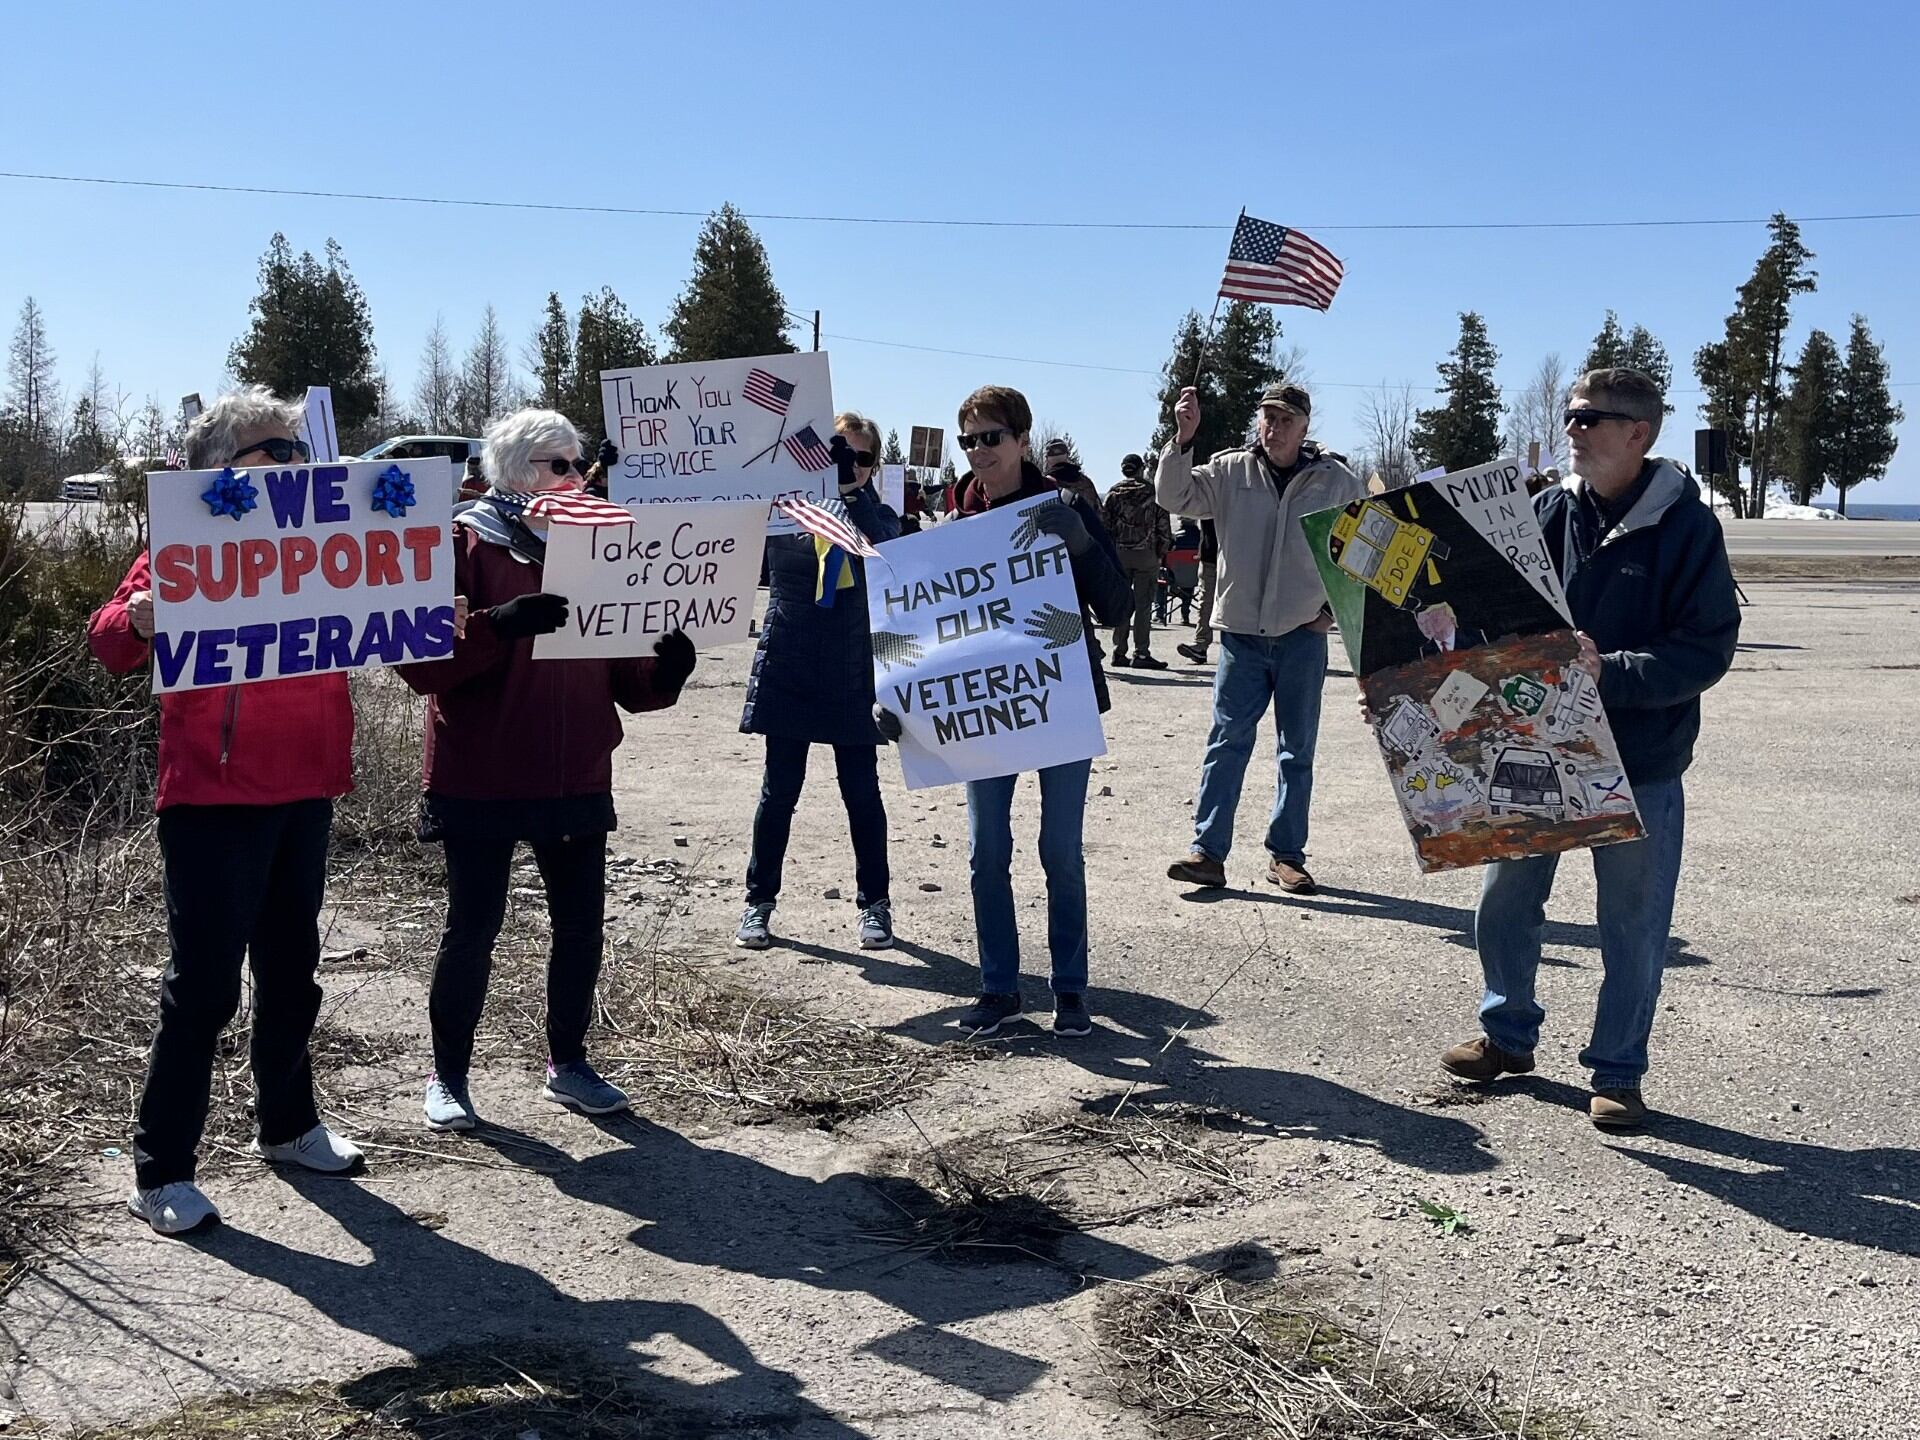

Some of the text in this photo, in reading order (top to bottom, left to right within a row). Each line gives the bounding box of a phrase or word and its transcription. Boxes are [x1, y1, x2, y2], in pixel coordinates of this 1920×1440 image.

[620, 415, 669, 449] FOR
[623, 450, 717, 480] SERVICE
[265, 466, 350, 529] WE
[1484, 501, 1516, 525] IN
[672, 522, 736, 560] Care
[1486, 521, 1533, 545] THE
[154, 525, 442, 604] SUPPORT
[626, 562, 718, 587] of OUR
[1390, 545, 1417, 582] DOE
[1505, 538, 1552, 574] Road
[883, 542, 1068, 615] HANDS OFF
[576, 597, 738, 638] VETERANS
[935, 597, 1015, 645] OUR
[153, 605, 456, 688] VETERANS
[894, 653, 1062, 714] VETERAN
[932, 689, 1050, 746] MONEY
